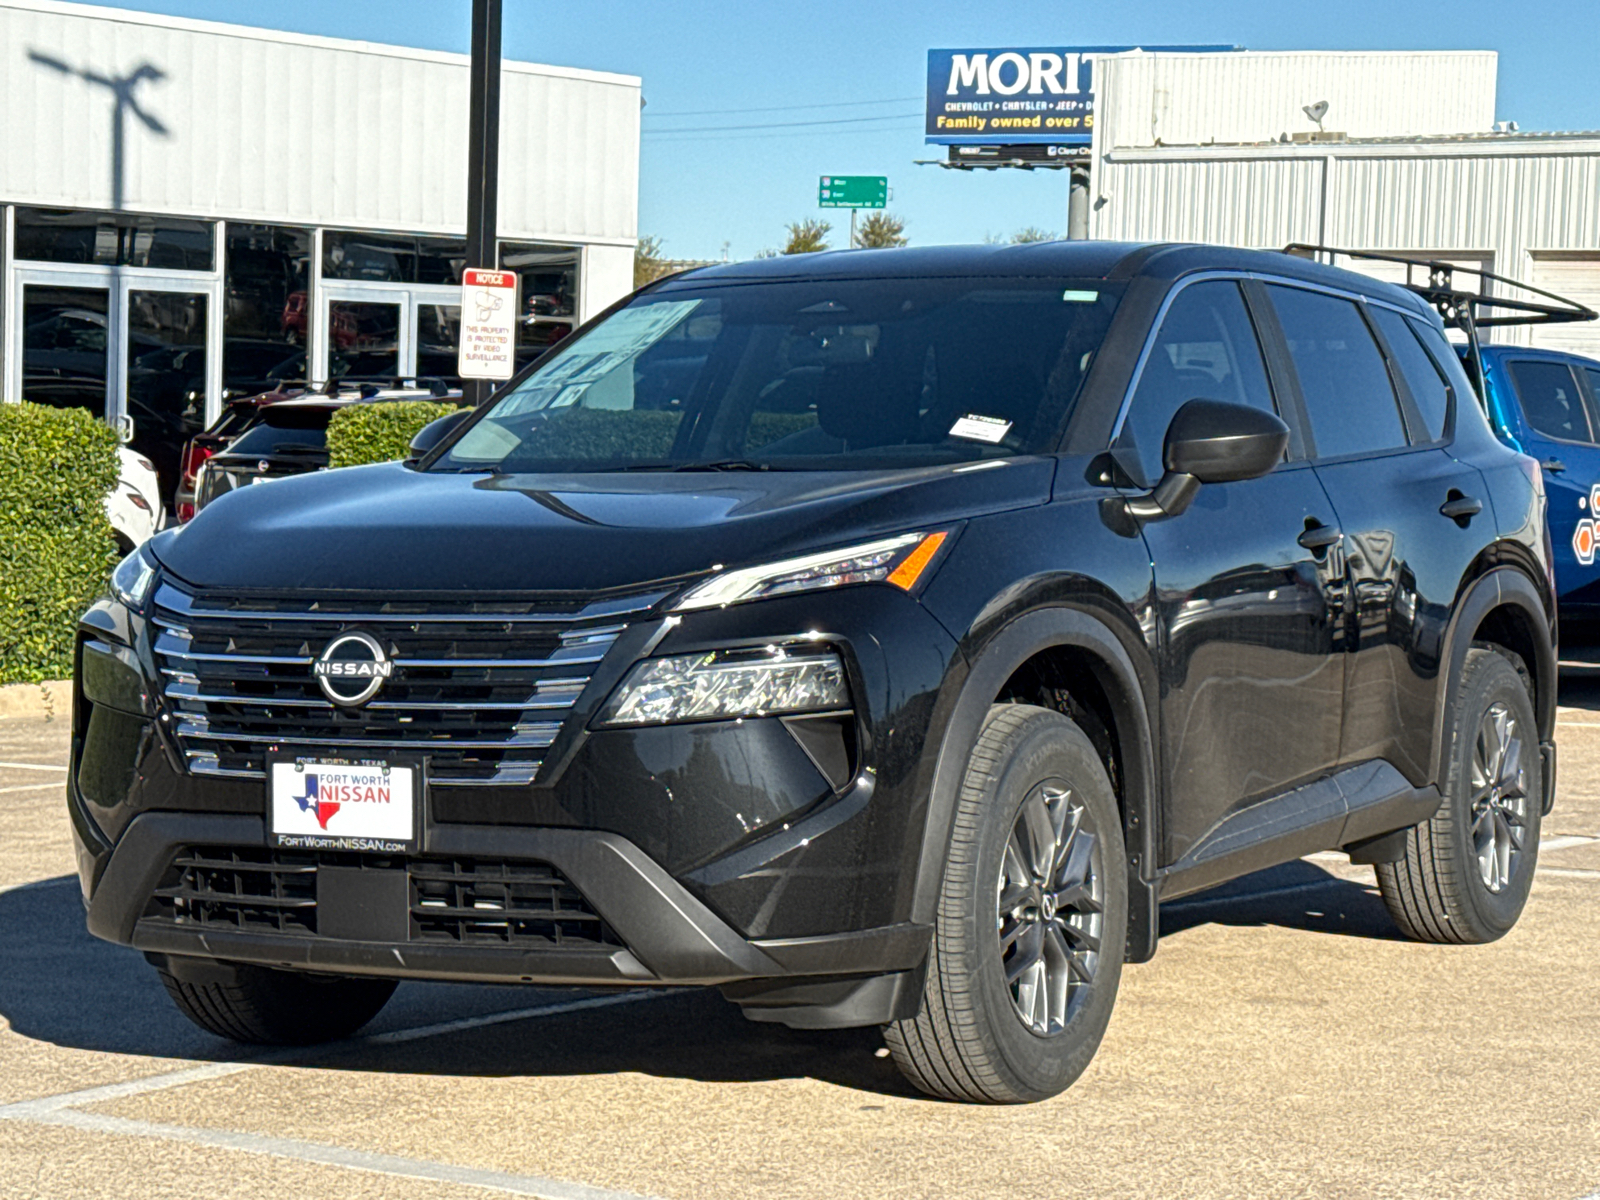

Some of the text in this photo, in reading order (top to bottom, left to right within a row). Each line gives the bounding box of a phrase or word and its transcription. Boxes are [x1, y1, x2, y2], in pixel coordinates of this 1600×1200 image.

[944, 101, 994, 112] CHEVROLET
[1002, 101, 1048, 111] CHRYSLER
[1055, 101, 1078, 111] JEEP
[936, 115, 987, 131] Family
[990, 115, 1041, 128] owned
[1045, 117, 1080, 128] over
[475, 272, 504, 285] NOTICE
[465, 325, 510, 335] THIS PROPERTY
[466, 334, 508, 344] IS PROTECTED
[473, 344, 501, 353] BY VIDEO
[465, 352, 508, 362] SURVEILLANCE
[314, 661, 391, 677] NISSAN
[295, 756, 388, 768] FORT WORTH TEXAS
[319, 773, 391, 787] FORT WORTH
[320, 784, 391, 804] NISSAN
